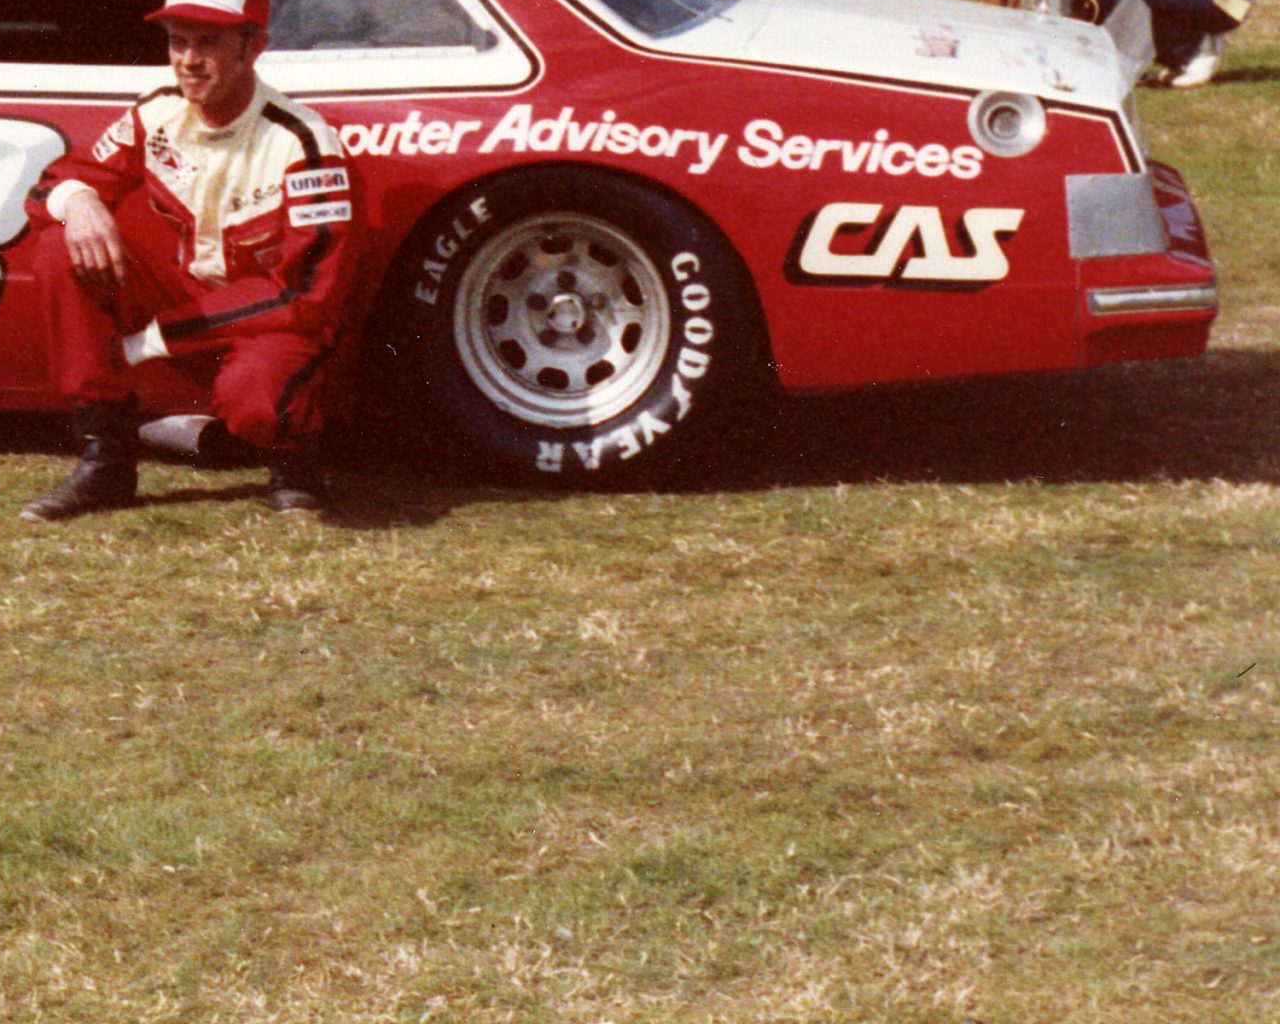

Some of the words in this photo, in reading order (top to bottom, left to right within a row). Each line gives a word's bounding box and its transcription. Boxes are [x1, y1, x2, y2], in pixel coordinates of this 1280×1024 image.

[332, 110, 483, 157] puter
[477, 104, 729, 175] Advisory
[737, 119, 984, 179] Services
[414, 196, 493, 306] EAGLE
[799, 202, 1026, 281] CAS
[535, 252, 714, 473] GOODYEAR
